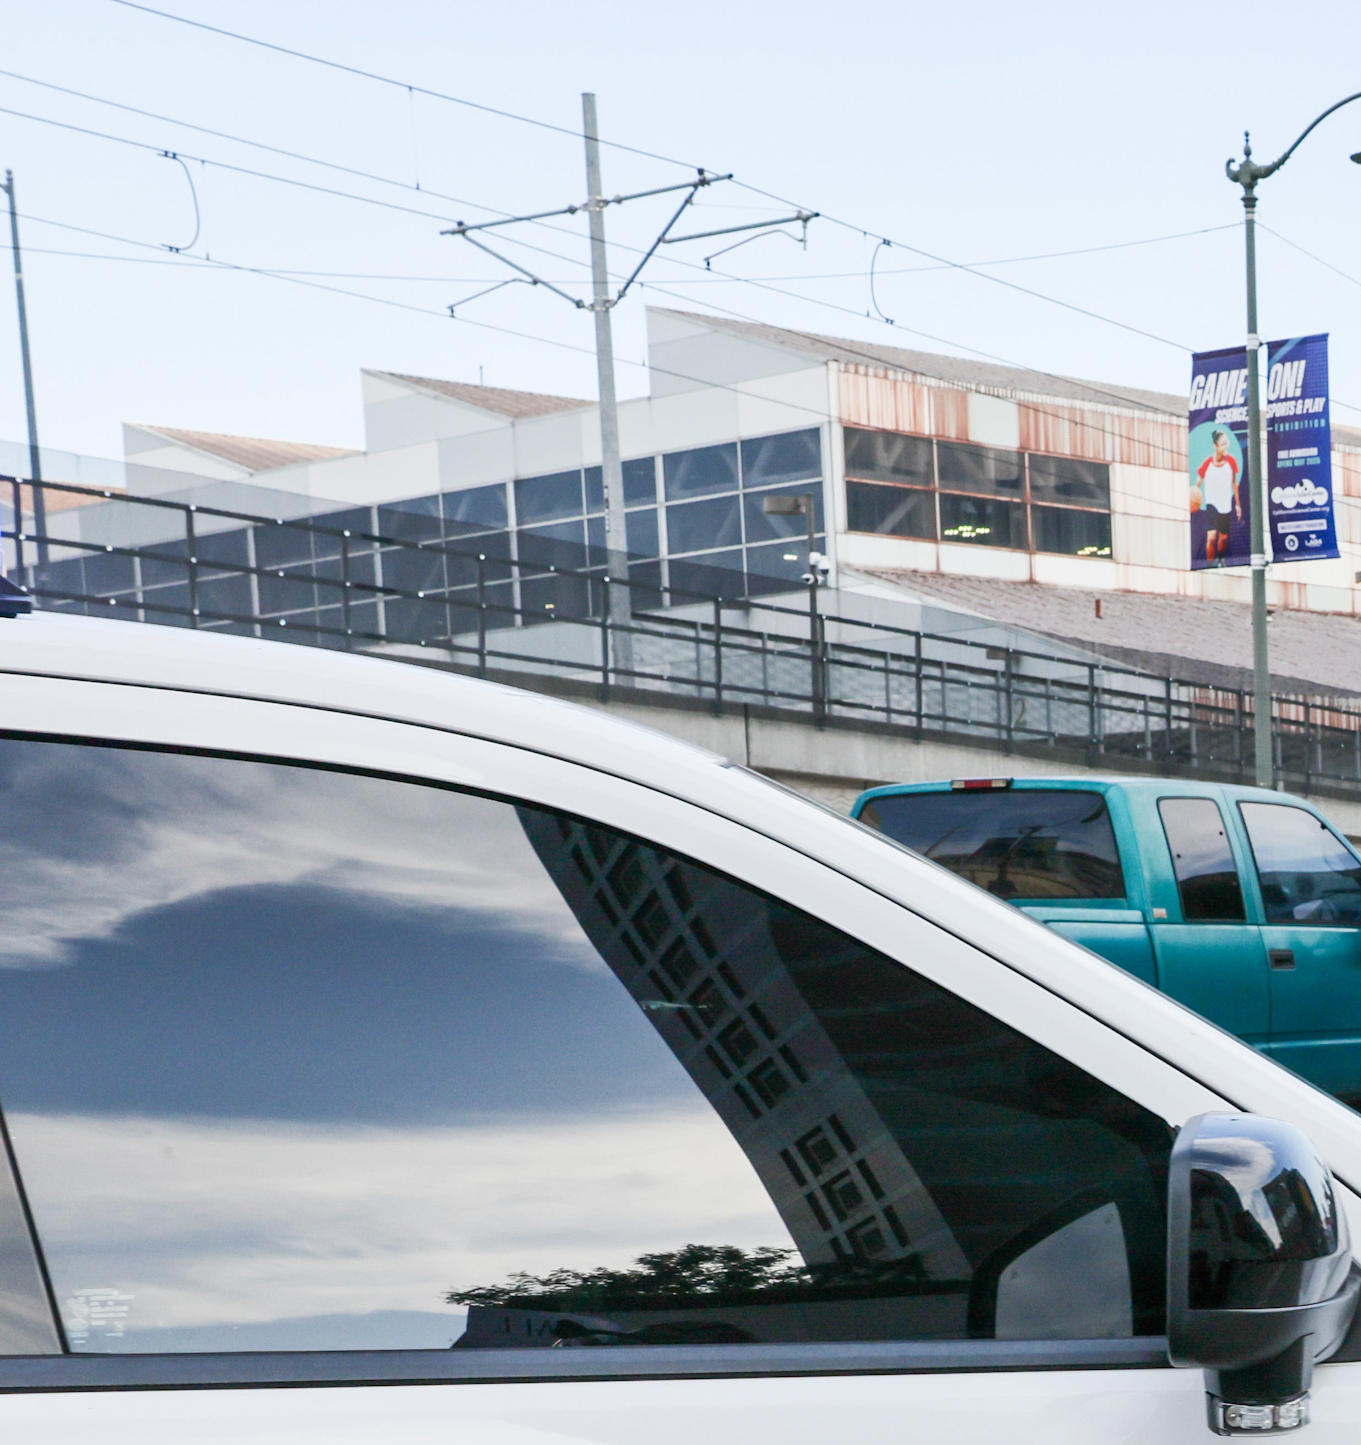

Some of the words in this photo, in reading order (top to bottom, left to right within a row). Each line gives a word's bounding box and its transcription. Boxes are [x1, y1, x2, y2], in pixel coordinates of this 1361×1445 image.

[1189, 368, 1248, 412] GAME
[1268, 359, 1306, 401] ON!
[1303, 397, 1326, 414] PLAY
